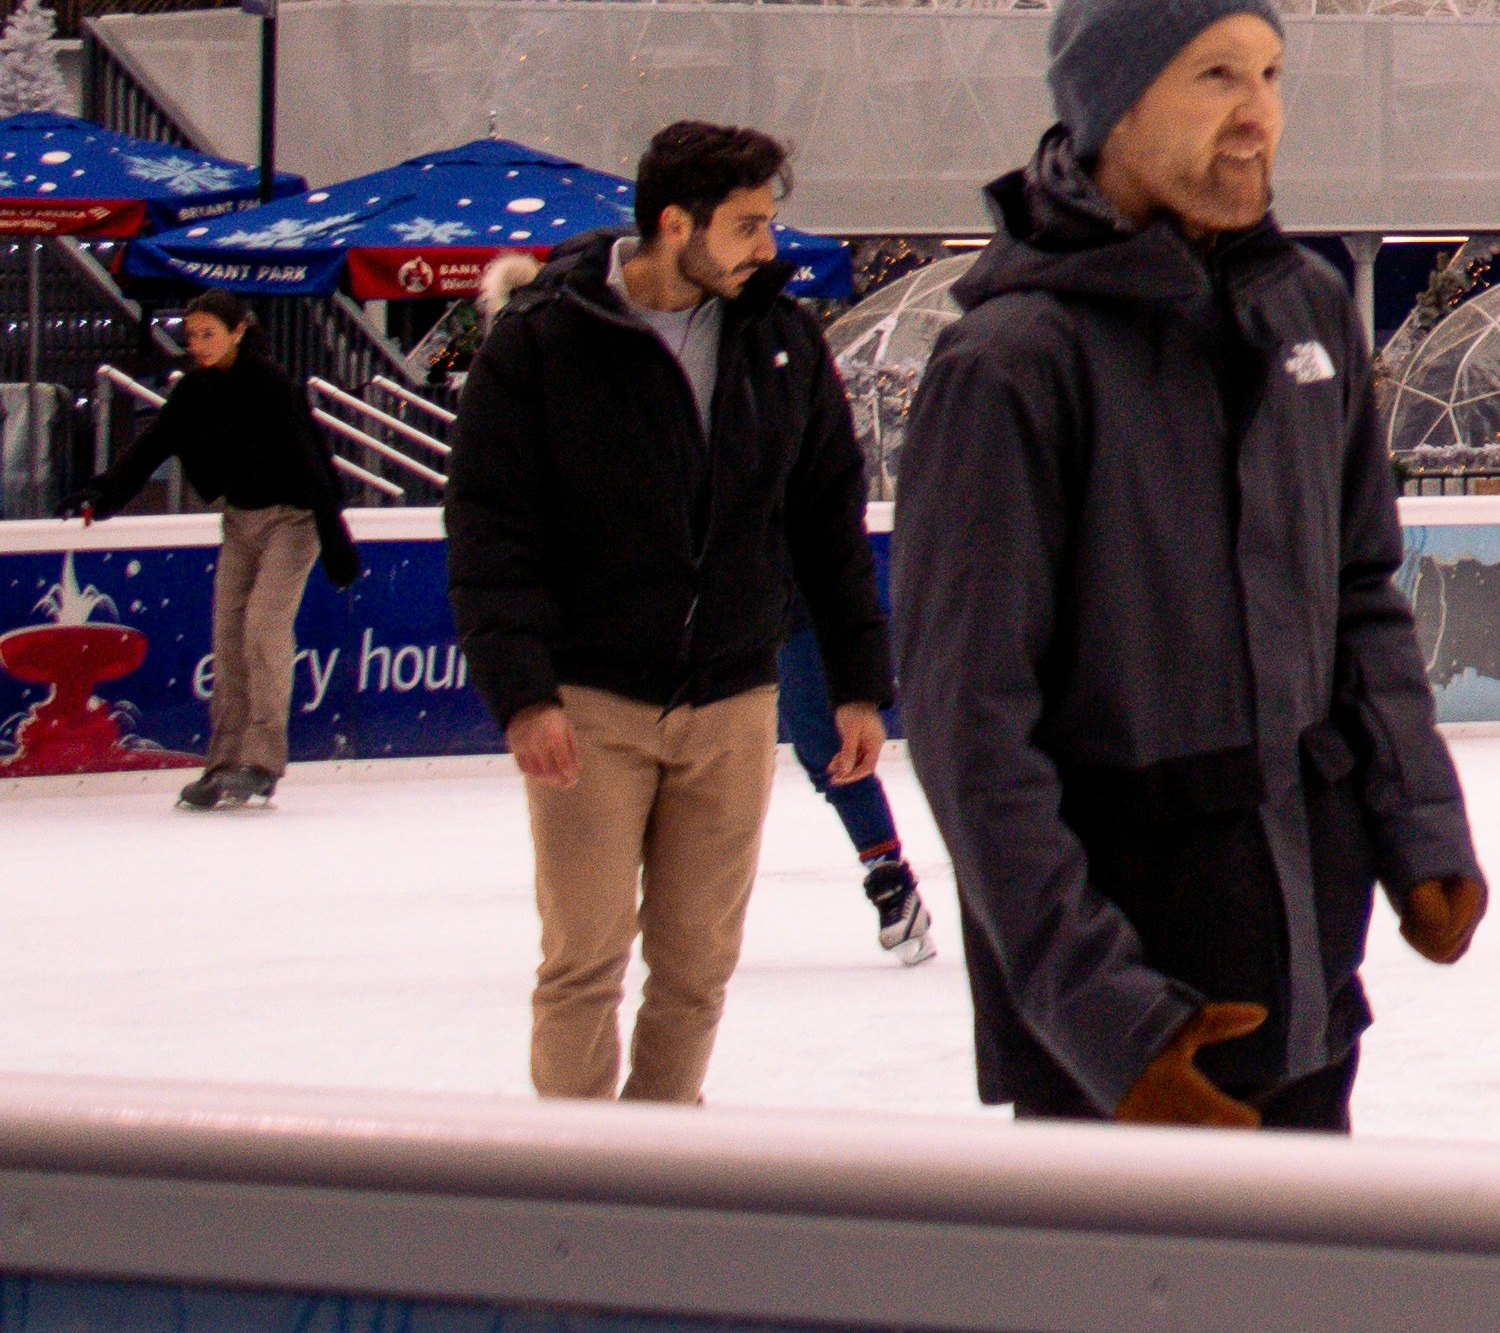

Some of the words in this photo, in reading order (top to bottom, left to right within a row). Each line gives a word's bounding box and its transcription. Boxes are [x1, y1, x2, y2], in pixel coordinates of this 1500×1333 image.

[178, 200, 234, 222] BRYANT
[256, 265, 308, 283] PARK
[439, 263, 481, 276] BANK
